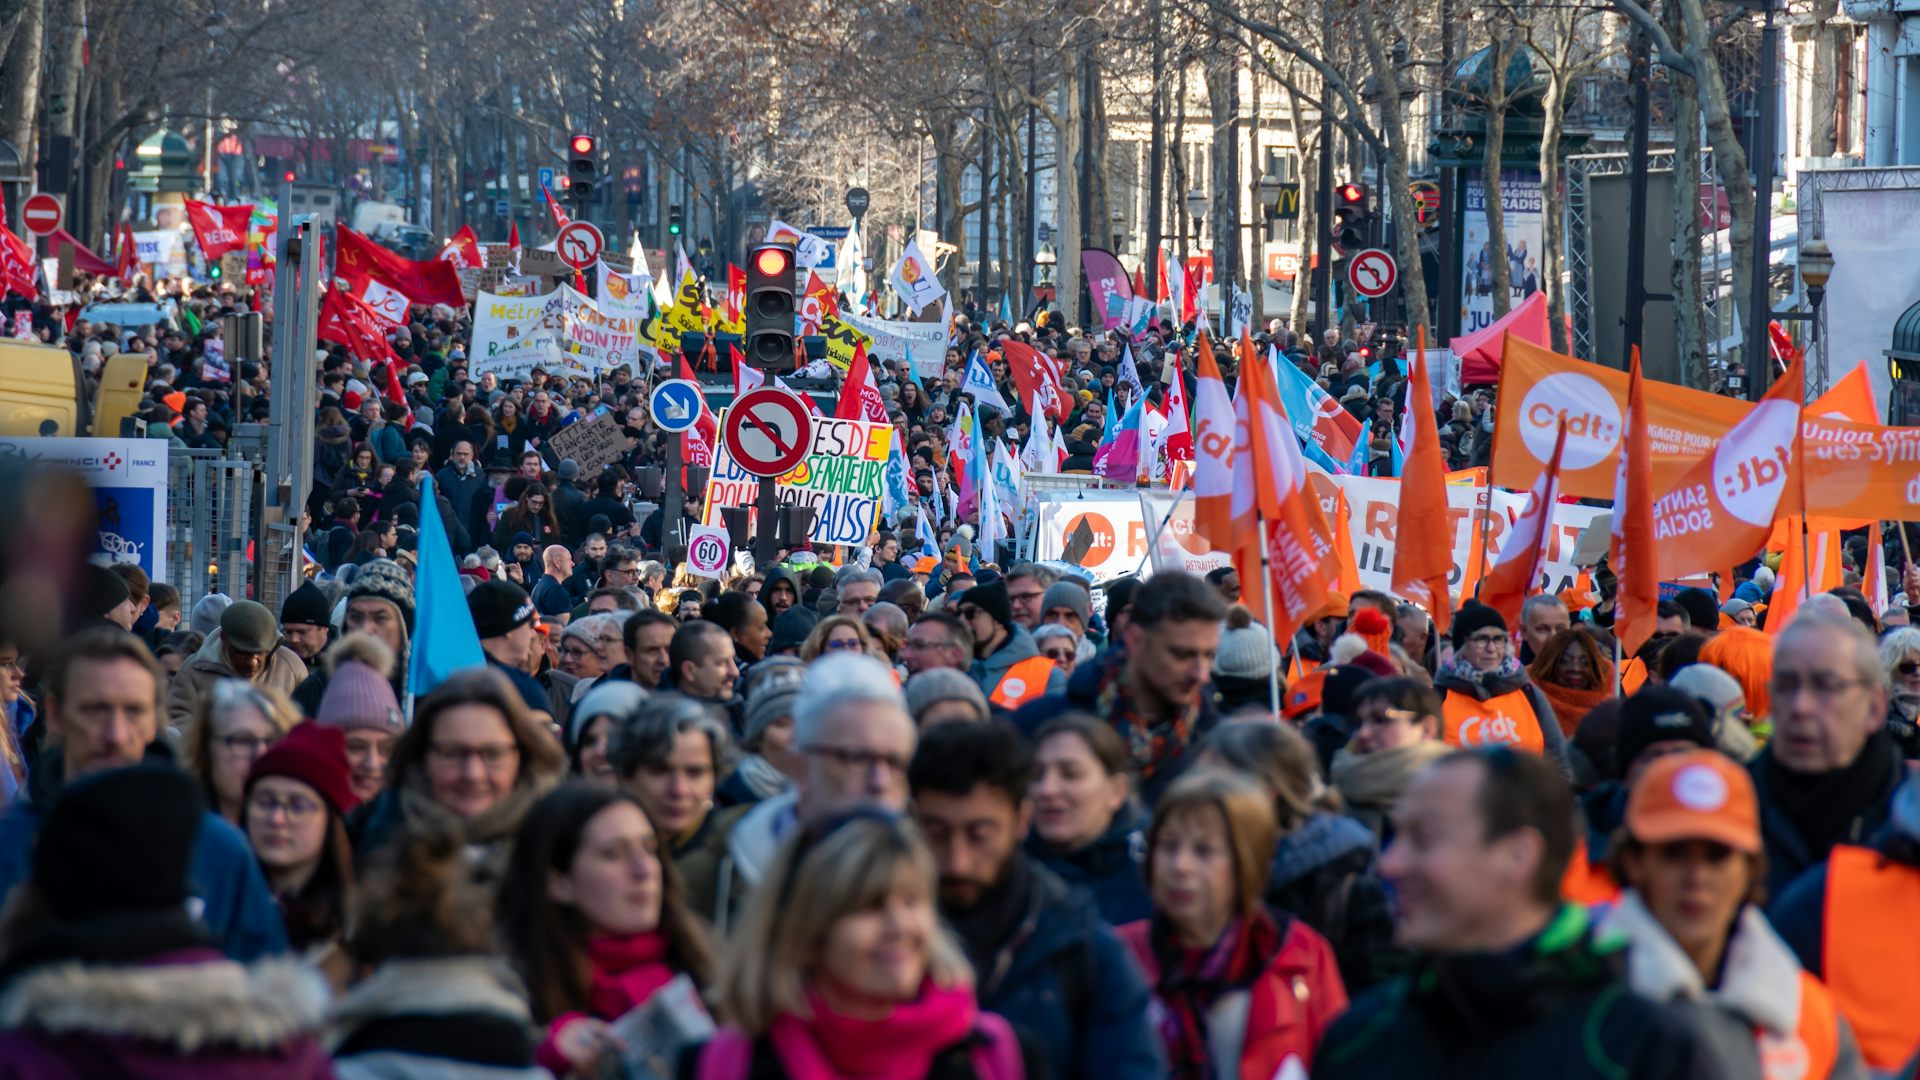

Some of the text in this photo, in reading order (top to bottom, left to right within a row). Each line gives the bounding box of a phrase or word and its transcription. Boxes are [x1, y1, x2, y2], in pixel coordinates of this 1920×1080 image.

[542, 171, 550, 184] P
[1467, 188, 1484, 197] POU
[1467, 197, 1479, 208] LE
[1468, 310, 1496, 333] JU
[874, 335, 919, 352] OBIGNY
[812, 418, 886, 460] ES DE
[1684, 431, 1711, 448] POUR
[1802, 422, 1874, 444] Union
[1652, 441, 1679, 454] POUR
[814, 494, 878, 543] AUSSI
[699, 541, 718, 561] 60
